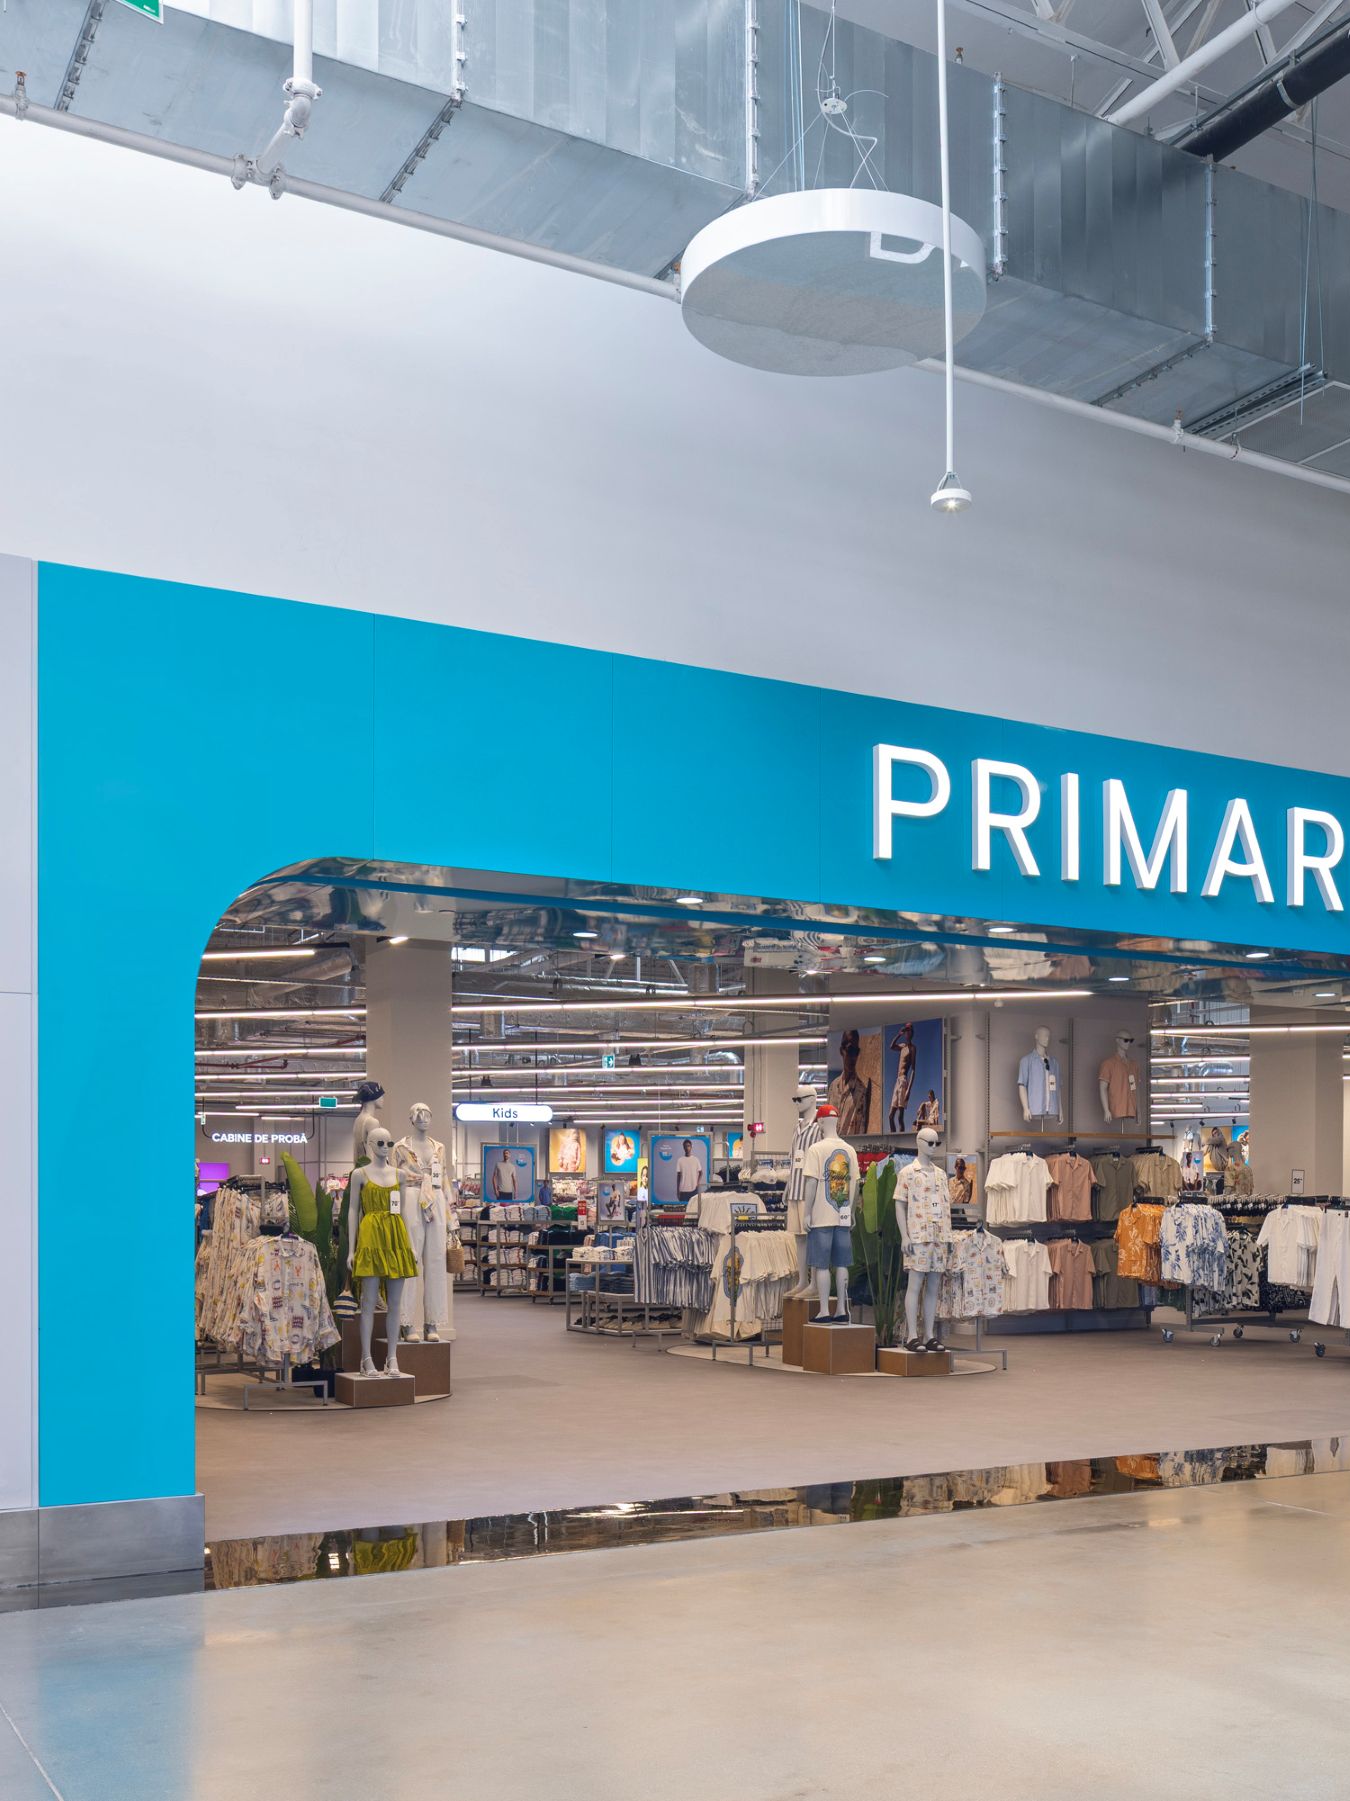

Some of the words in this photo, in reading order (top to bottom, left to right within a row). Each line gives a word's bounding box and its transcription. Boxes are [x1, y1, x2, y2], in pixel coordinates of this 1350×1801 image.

[492, 1107, 519, 1119] Kids
[211, 1132, 252, 1143] CABINE
[254, 1133, 269, 1144] DE
